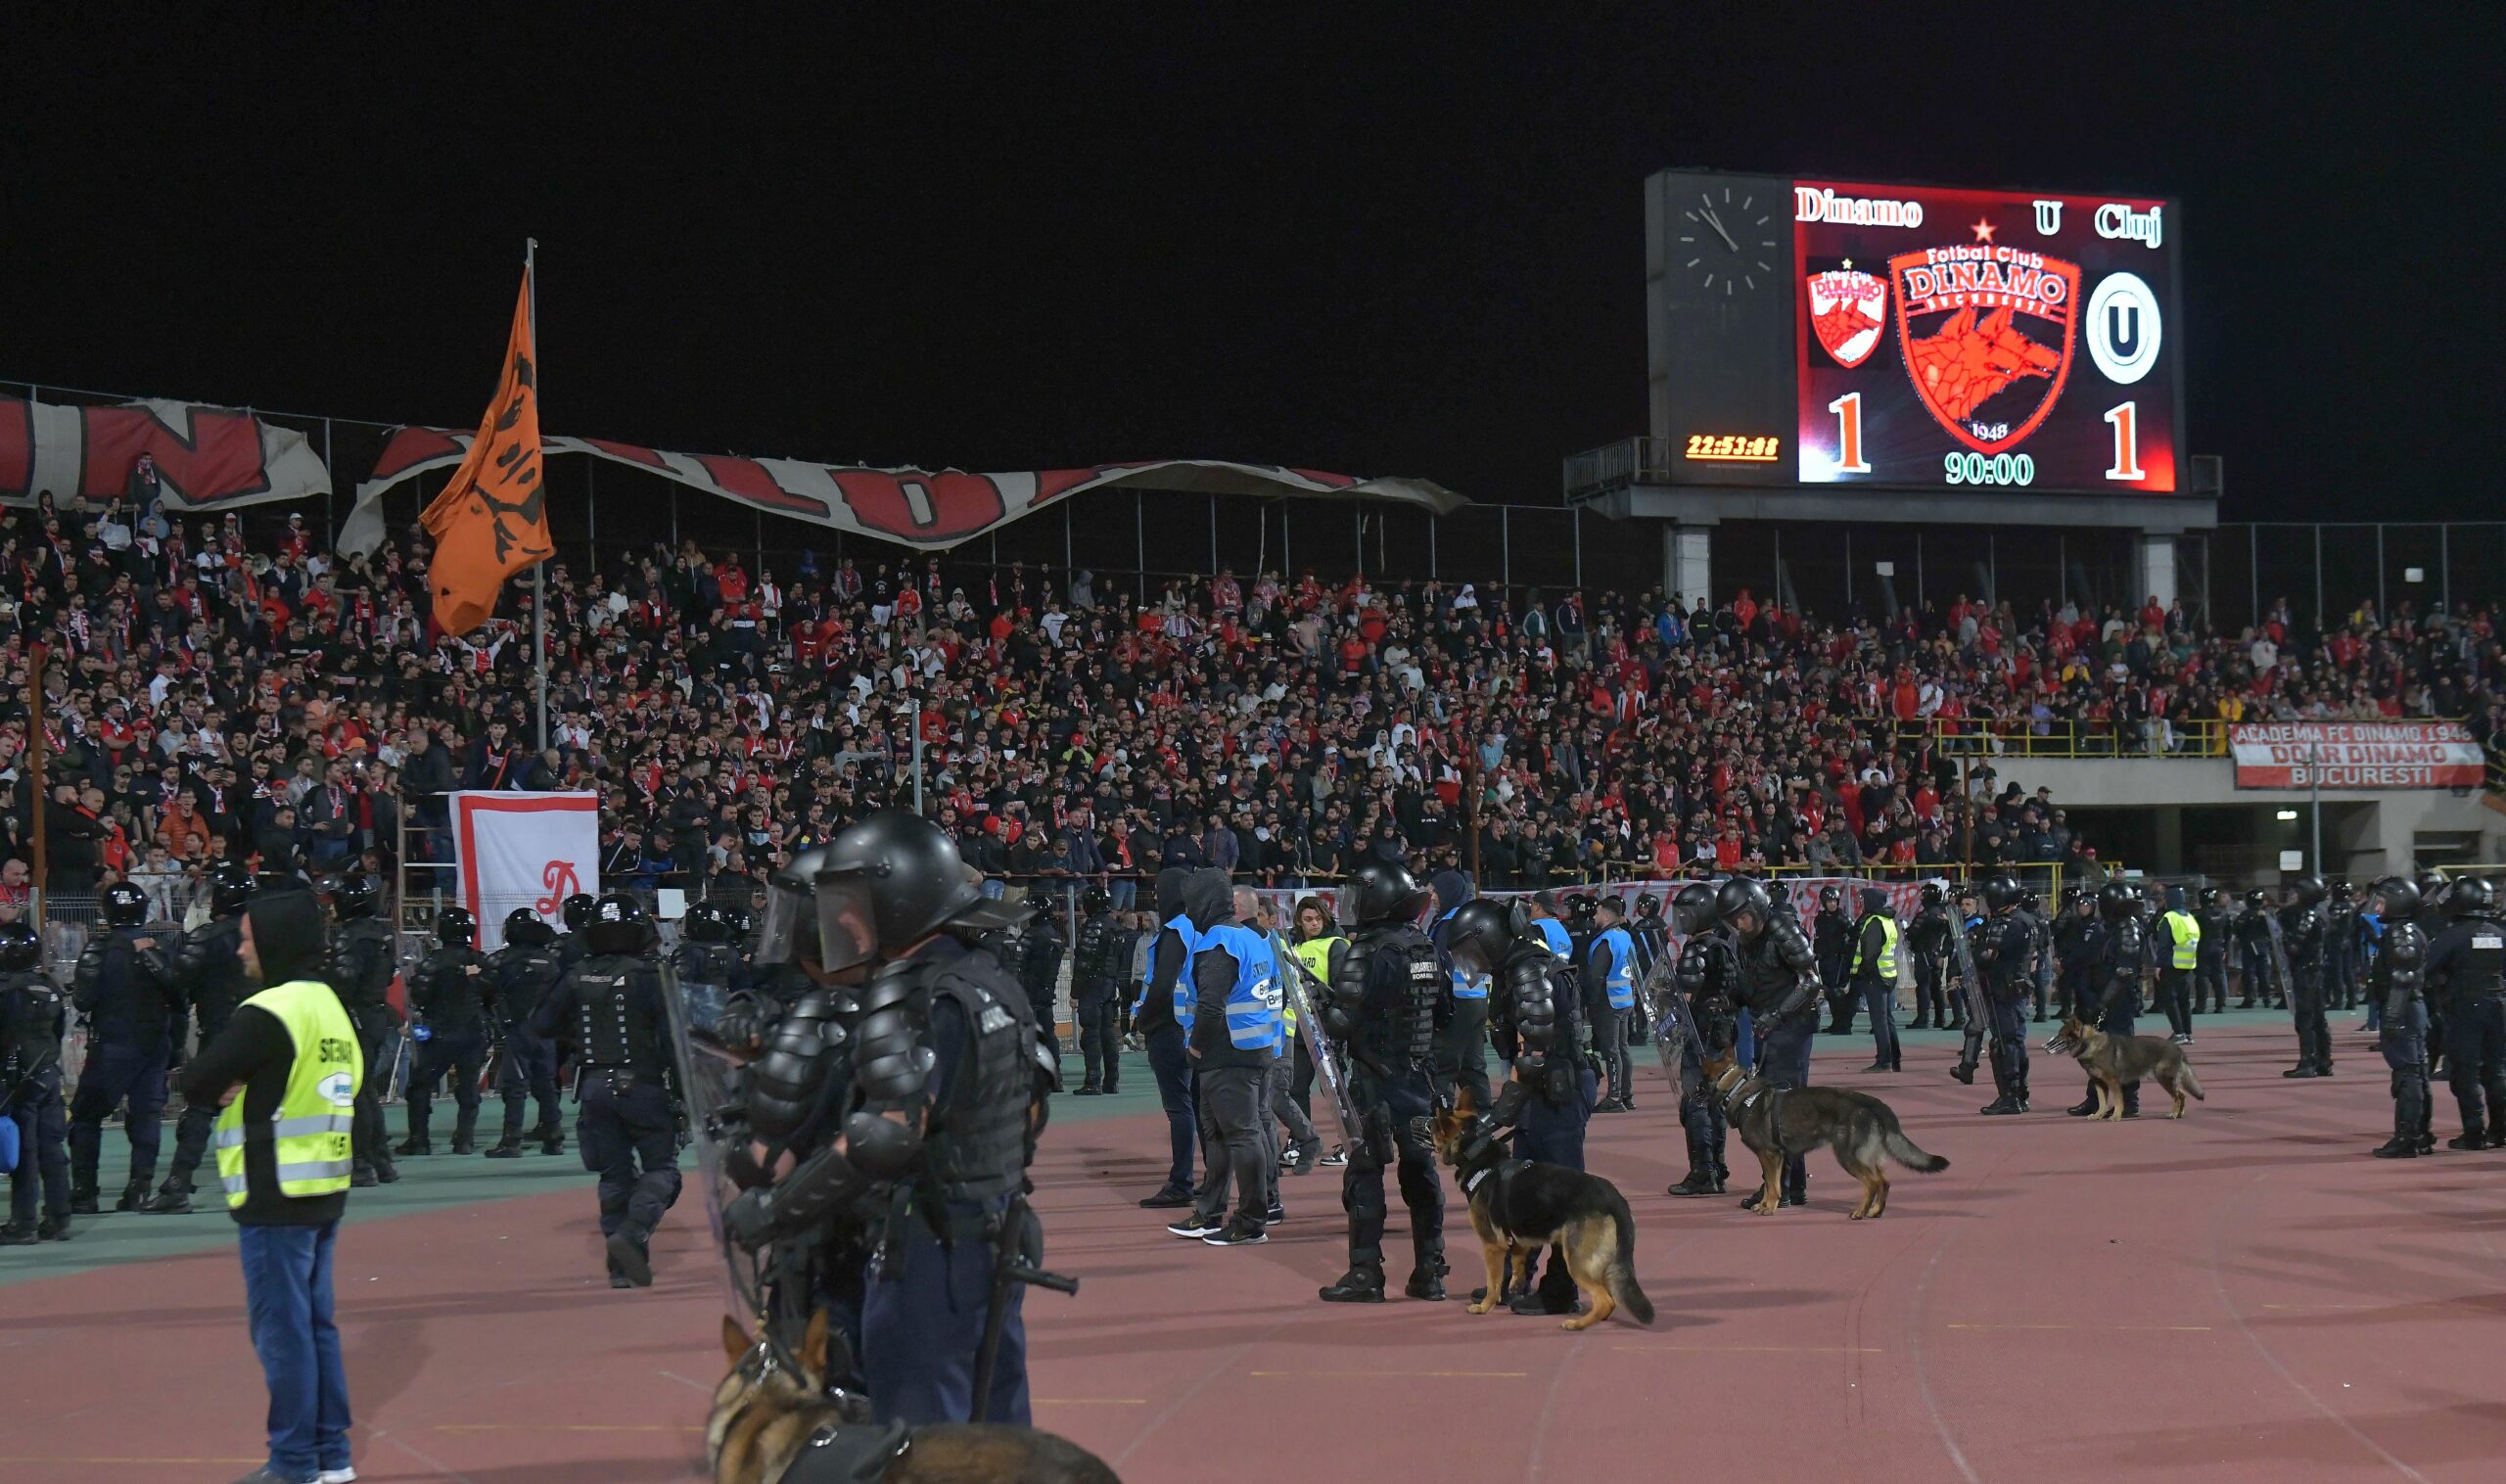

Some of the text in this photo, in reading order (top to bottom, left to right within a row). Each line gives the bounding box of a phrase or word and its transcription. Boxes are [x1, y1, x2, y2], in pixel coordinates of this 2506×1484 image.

[1794, 187, 2162, 250] Dinamo U Cluj
[1926, 246, 2044, 269] Fotbal Club
[1906, 261, 2066, 304] DINAMO
[2108, 305, 2139, 357] U
[1828, 392, 2146, 481] 1 1
[1970, 422, 2009, 441] 1948
[1944, 451, 2035, 487] 90:00
[2237, 725, 2325, 742] ACADEMIA
[2327, 725, 2350, 742] FC
[2352, 725, 2422, 742] DINAMO
[2271, 745, 2448, 765] DOAR DINAMO
[2292, 765, 2433, 784] BUCURESTI
